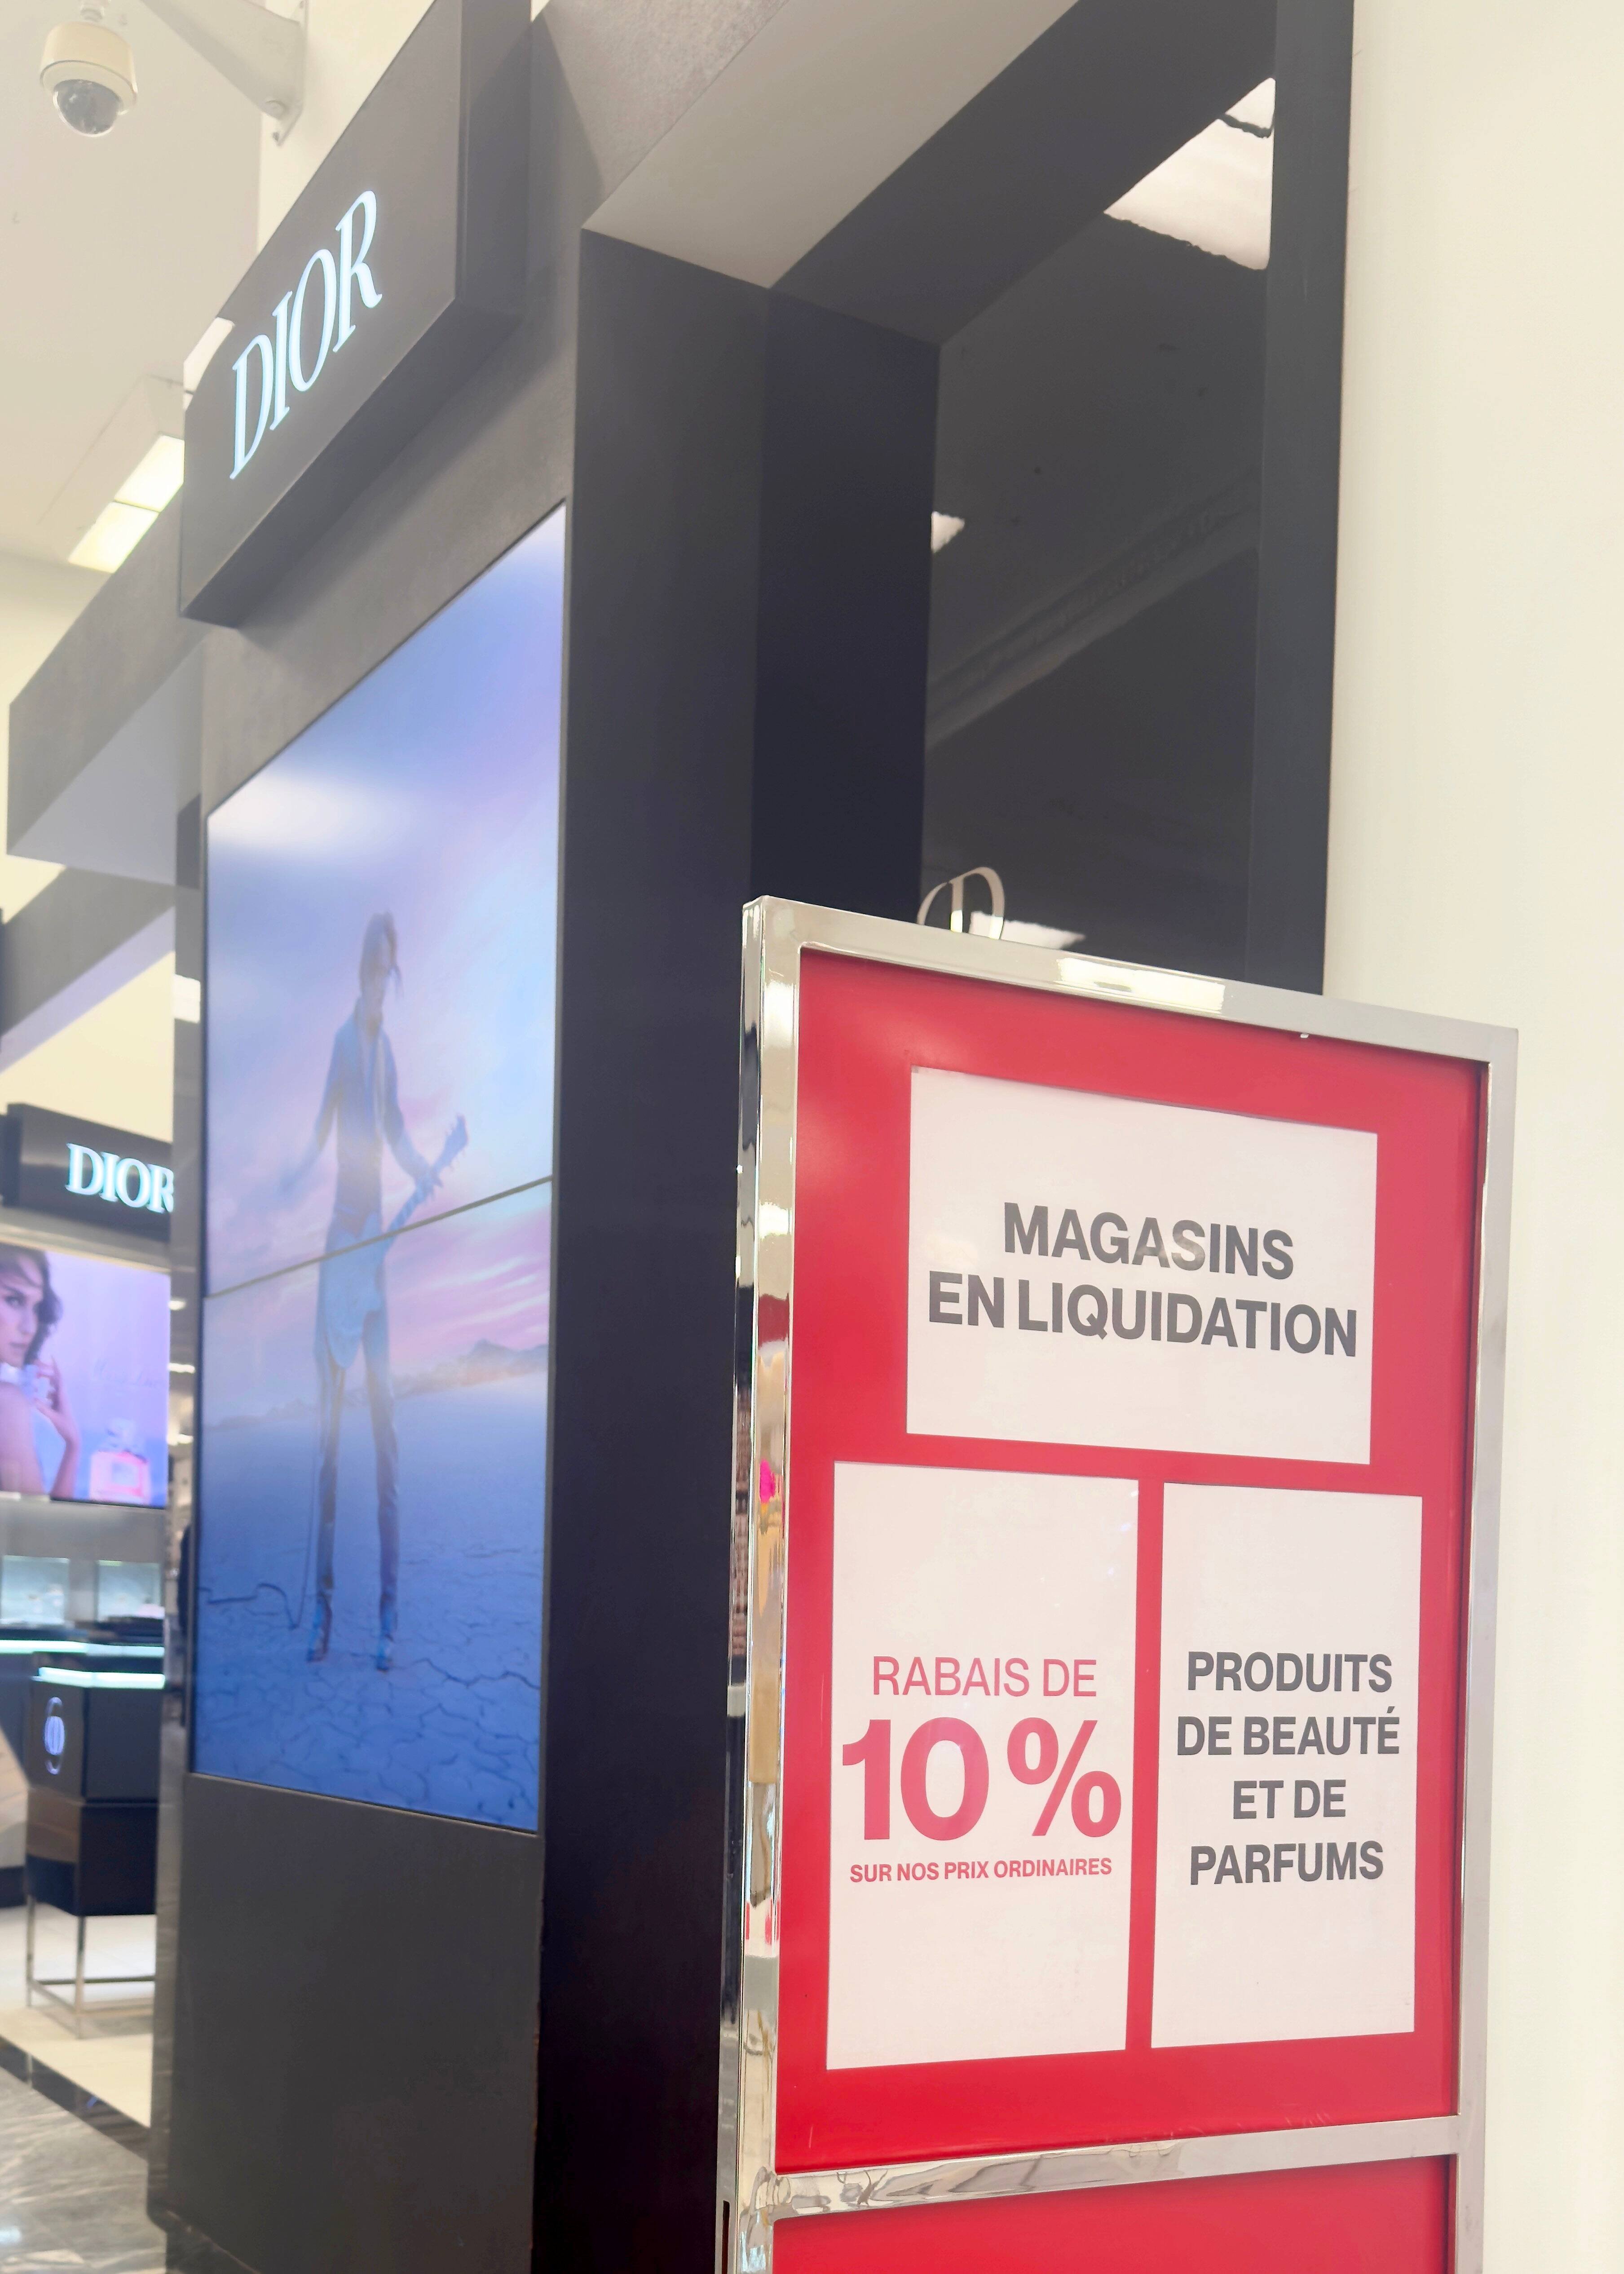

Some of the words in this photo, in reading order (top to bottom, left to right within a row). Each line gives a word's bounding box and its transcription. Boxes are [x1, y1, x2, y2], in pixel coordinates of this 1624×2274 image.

[229, 190, 383, 480] DIOR
[65, 1142, 174, 1213] DIOR
[1004, 1202, 1294, 1280] MAGASINS
[929, 1270, 1005, 1328] EN
[1018, 1279, 1357, 1357] LIQUIDATION
[874, 1656, 1030, 1697] RABAIS
[1043, 1659, 1097, 1697] DE
[1188, 1651, 1392, 1693] PRODUITS
[1177, 1716, 1232, 1756] DE
[1244, 1706, 1400, 1756] BEAUTÉ
[1233, 1780, 1284, 1819] ET
[1294, 1779, 1346, 1818] DE
[850, 1864, 892, 1883] SUR
[897, 1862, 939, 1881] NOS
[944, 1861, 989, 1880] PRIX
[993, 1857, 1112, 1878] ORDINAIRES
[1190, 1840, 1384, 1885] PARFUMS
